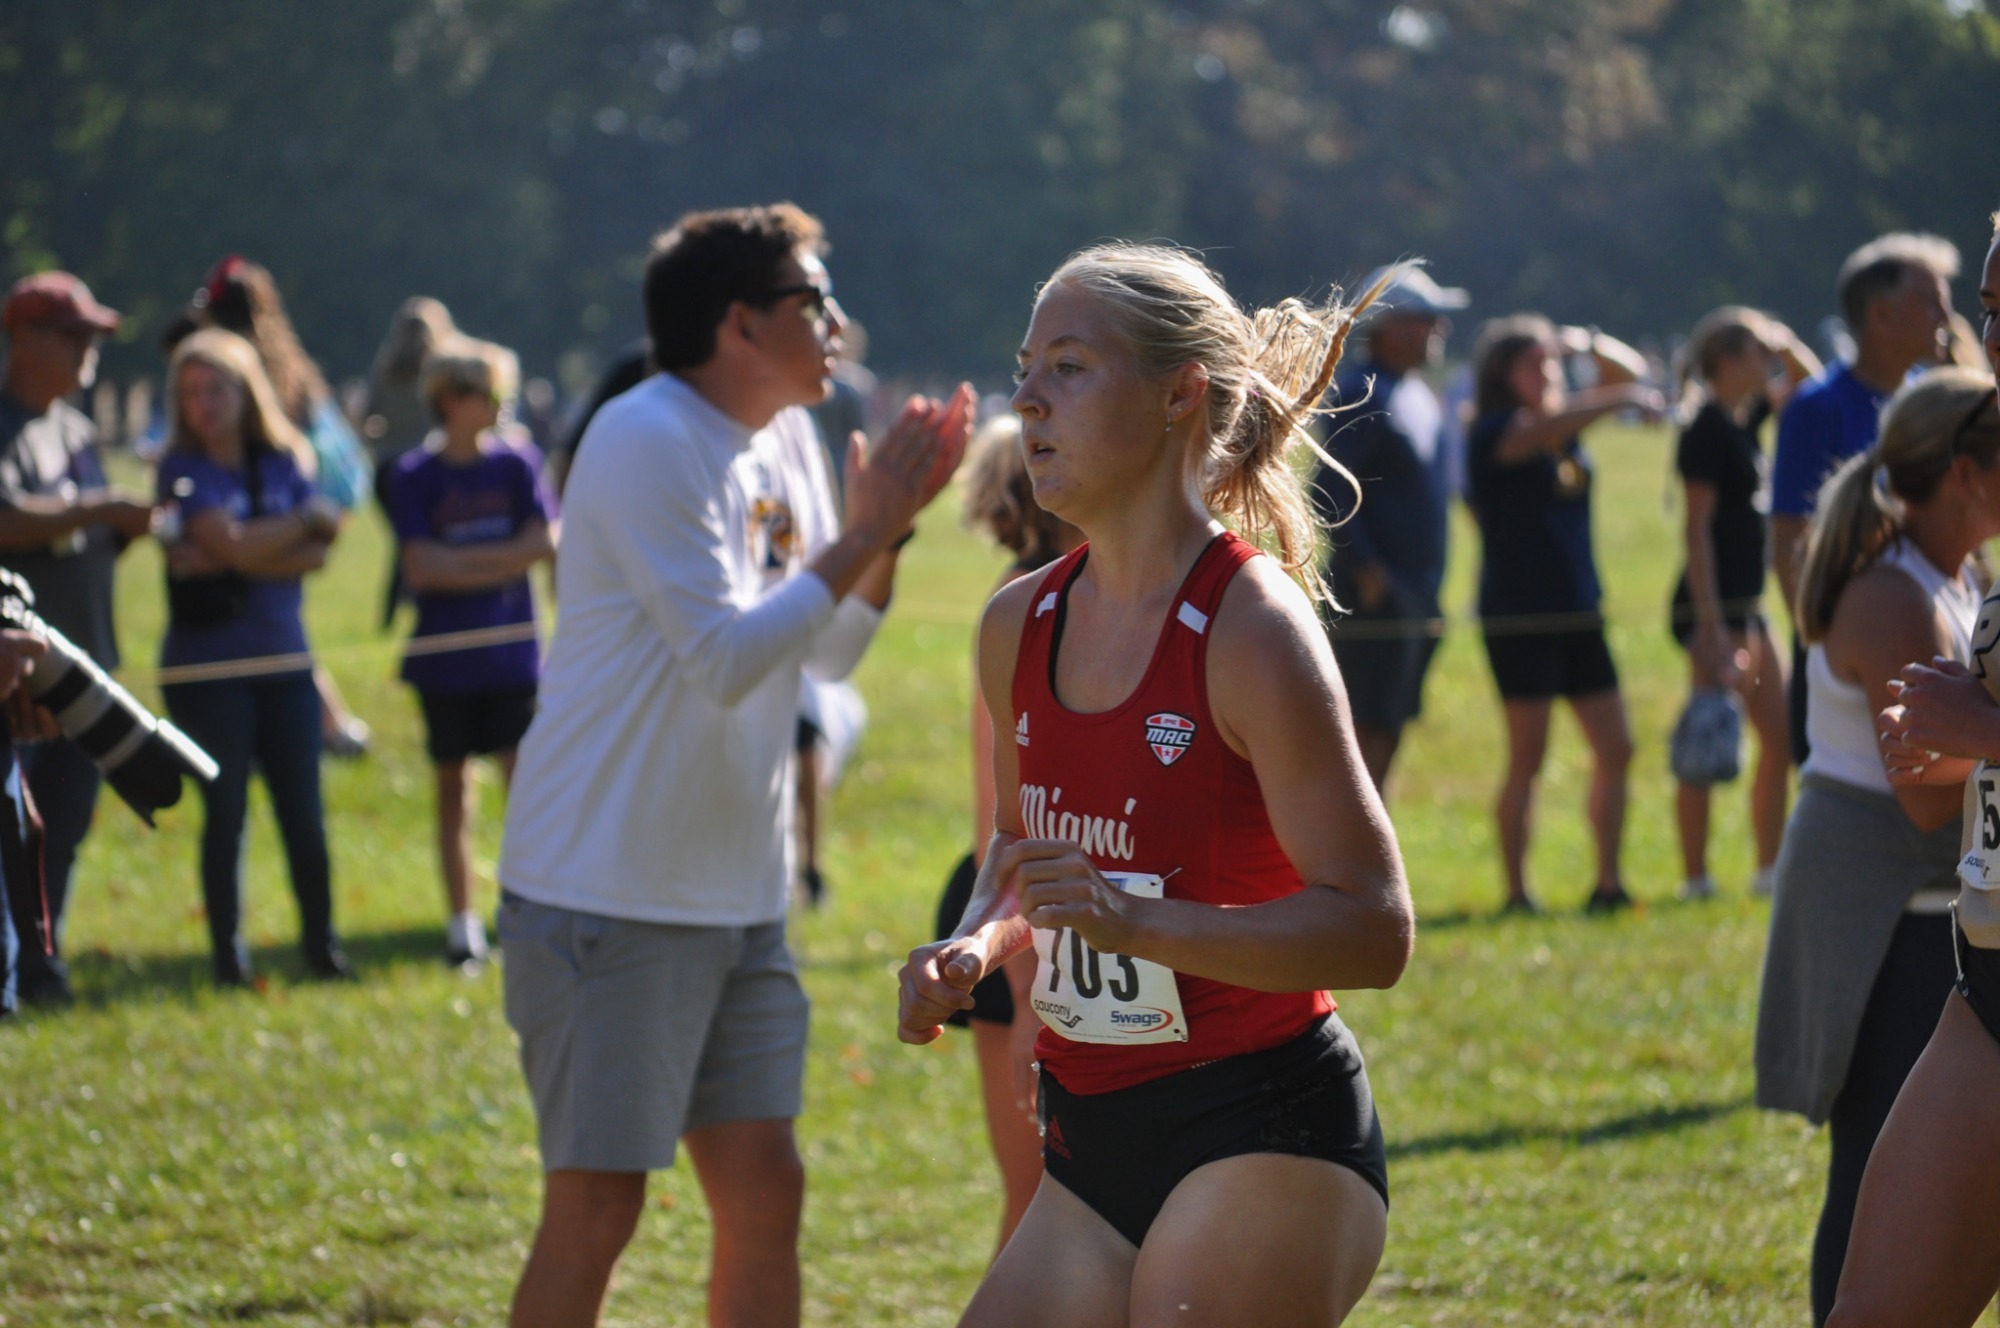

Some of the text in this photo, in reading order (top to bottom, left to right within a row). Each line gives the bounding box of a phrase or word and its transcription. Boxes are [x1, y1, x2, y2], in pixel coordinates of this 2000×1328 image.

[1146, 728, 1192, 745] MAC
[1020, 783, 1136, 860] Miami
[1034, 999, 1071, 1019] saucony
[1111, 1010, 1161, 1026] Swags
